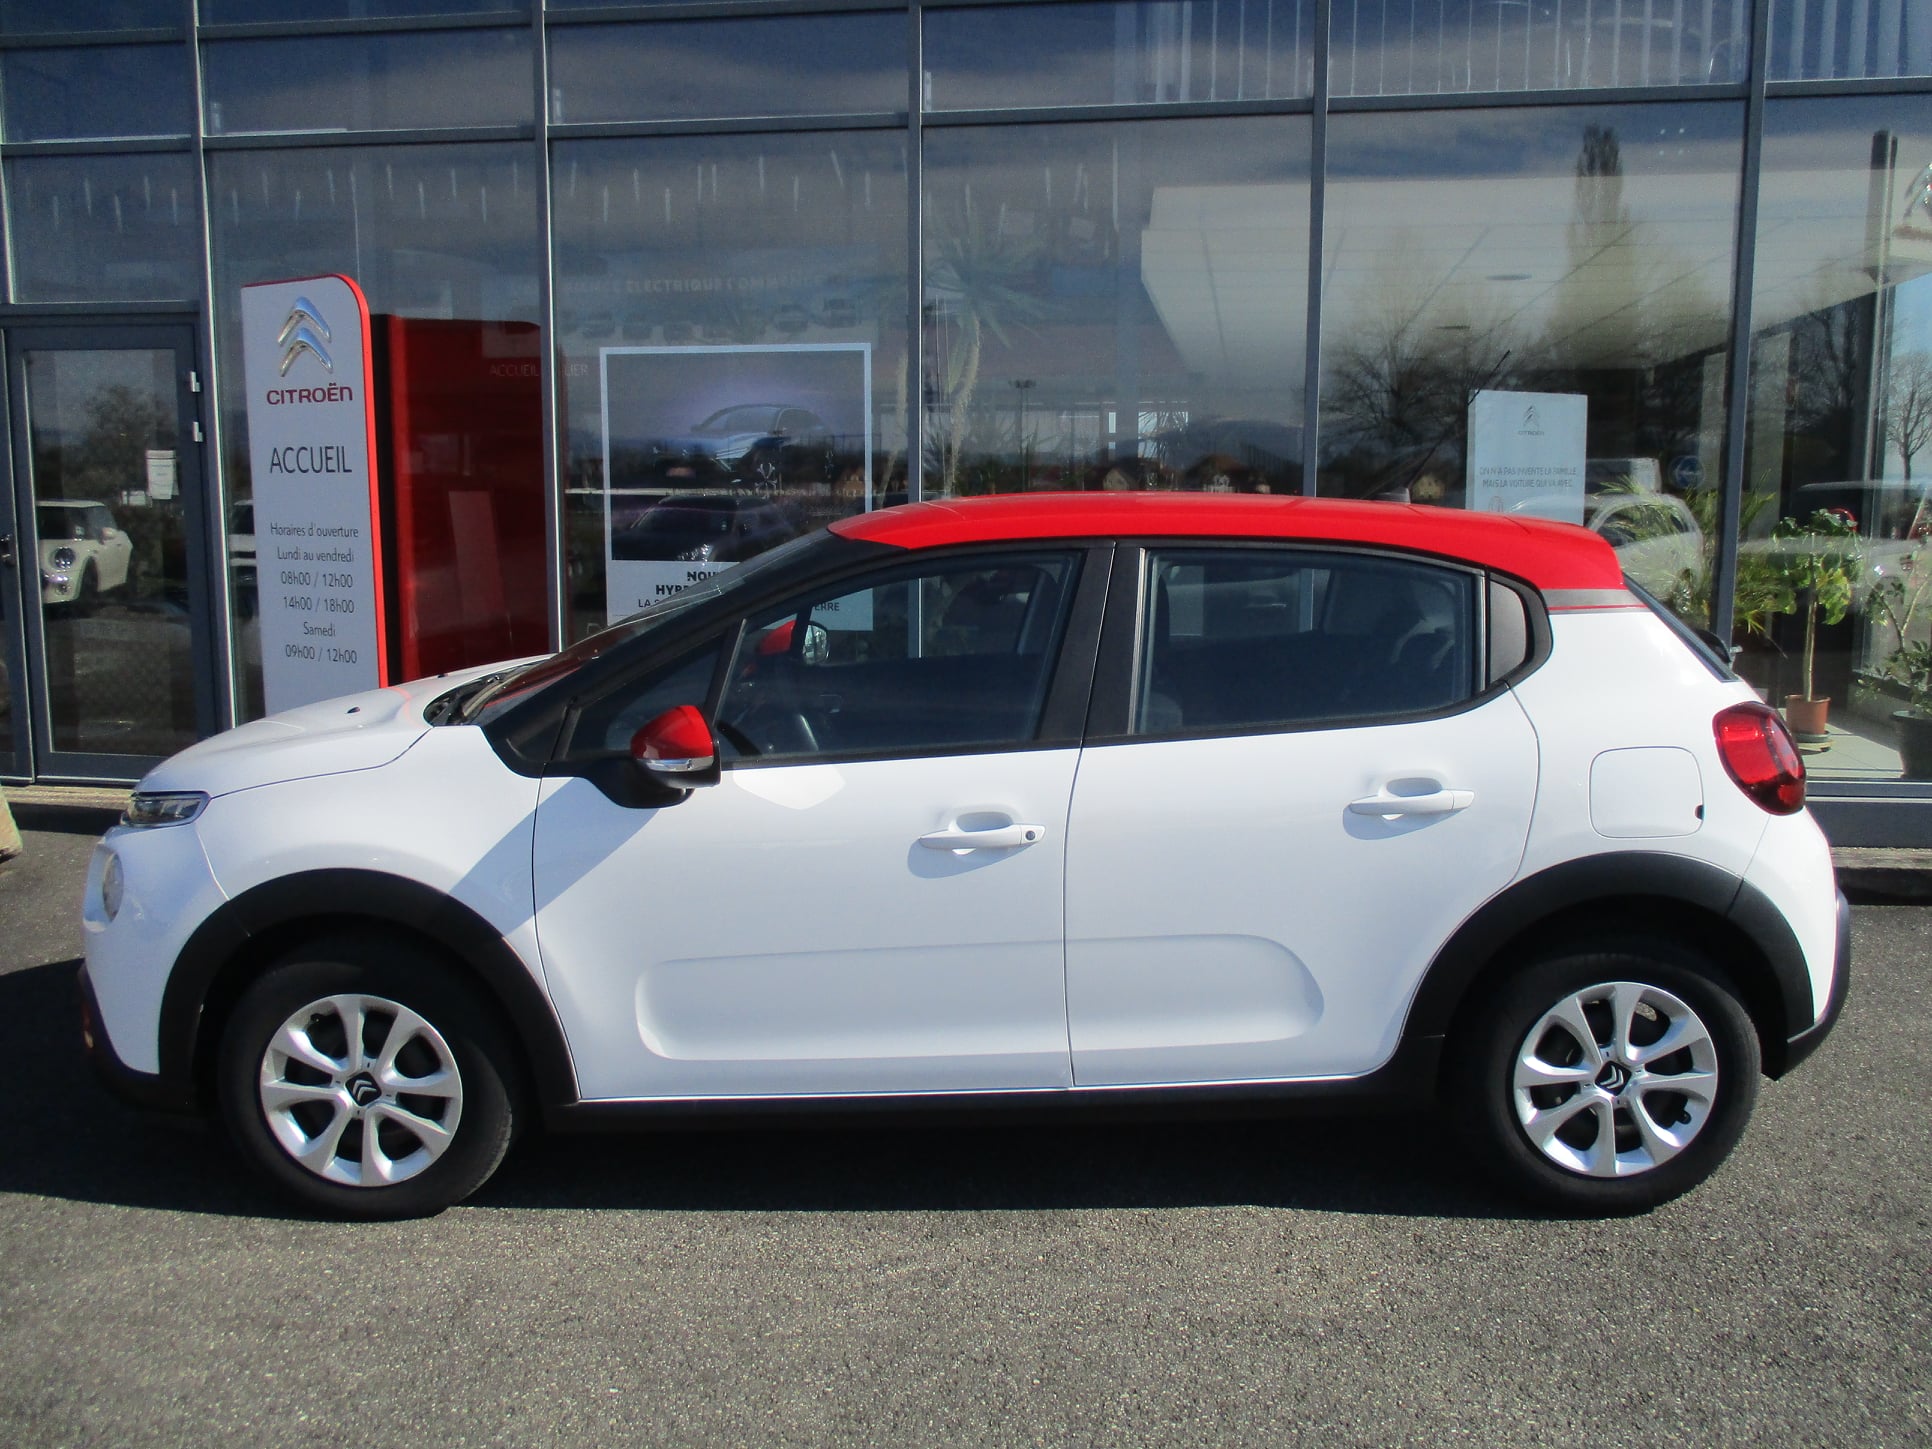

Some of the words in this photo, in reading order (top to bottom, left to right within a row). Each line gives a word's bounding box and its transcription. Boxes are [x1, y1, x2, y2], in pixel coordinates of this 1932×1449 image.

[489, 363, 540, 377] ACCUEIL
[269, 446, 353, 475] ACCUEIL
[270, 522, 306, 537] Horaires
[308, 522, 359, 538] d'ouverture
[277, 547, 301, 561] Lundi
[303, 551, 314, 561] au
[316, 548, 354, 562] vendredi
[280, 571, 311, 586] 08h00
[322, 573, 354, 588] 12h00
[687, 571, 716, 581] NOU
[283, 596, 313, 611] 14h00
[324, 599, 355, 614] 18h00
[638, 598, 651, 608] LA
[815, 602, 840, 611] ERRE
[303, 621, 336, 637] Samedi
[285, 644, 315, 660] 09h00
[327, 648, 358, 664] 12h00
